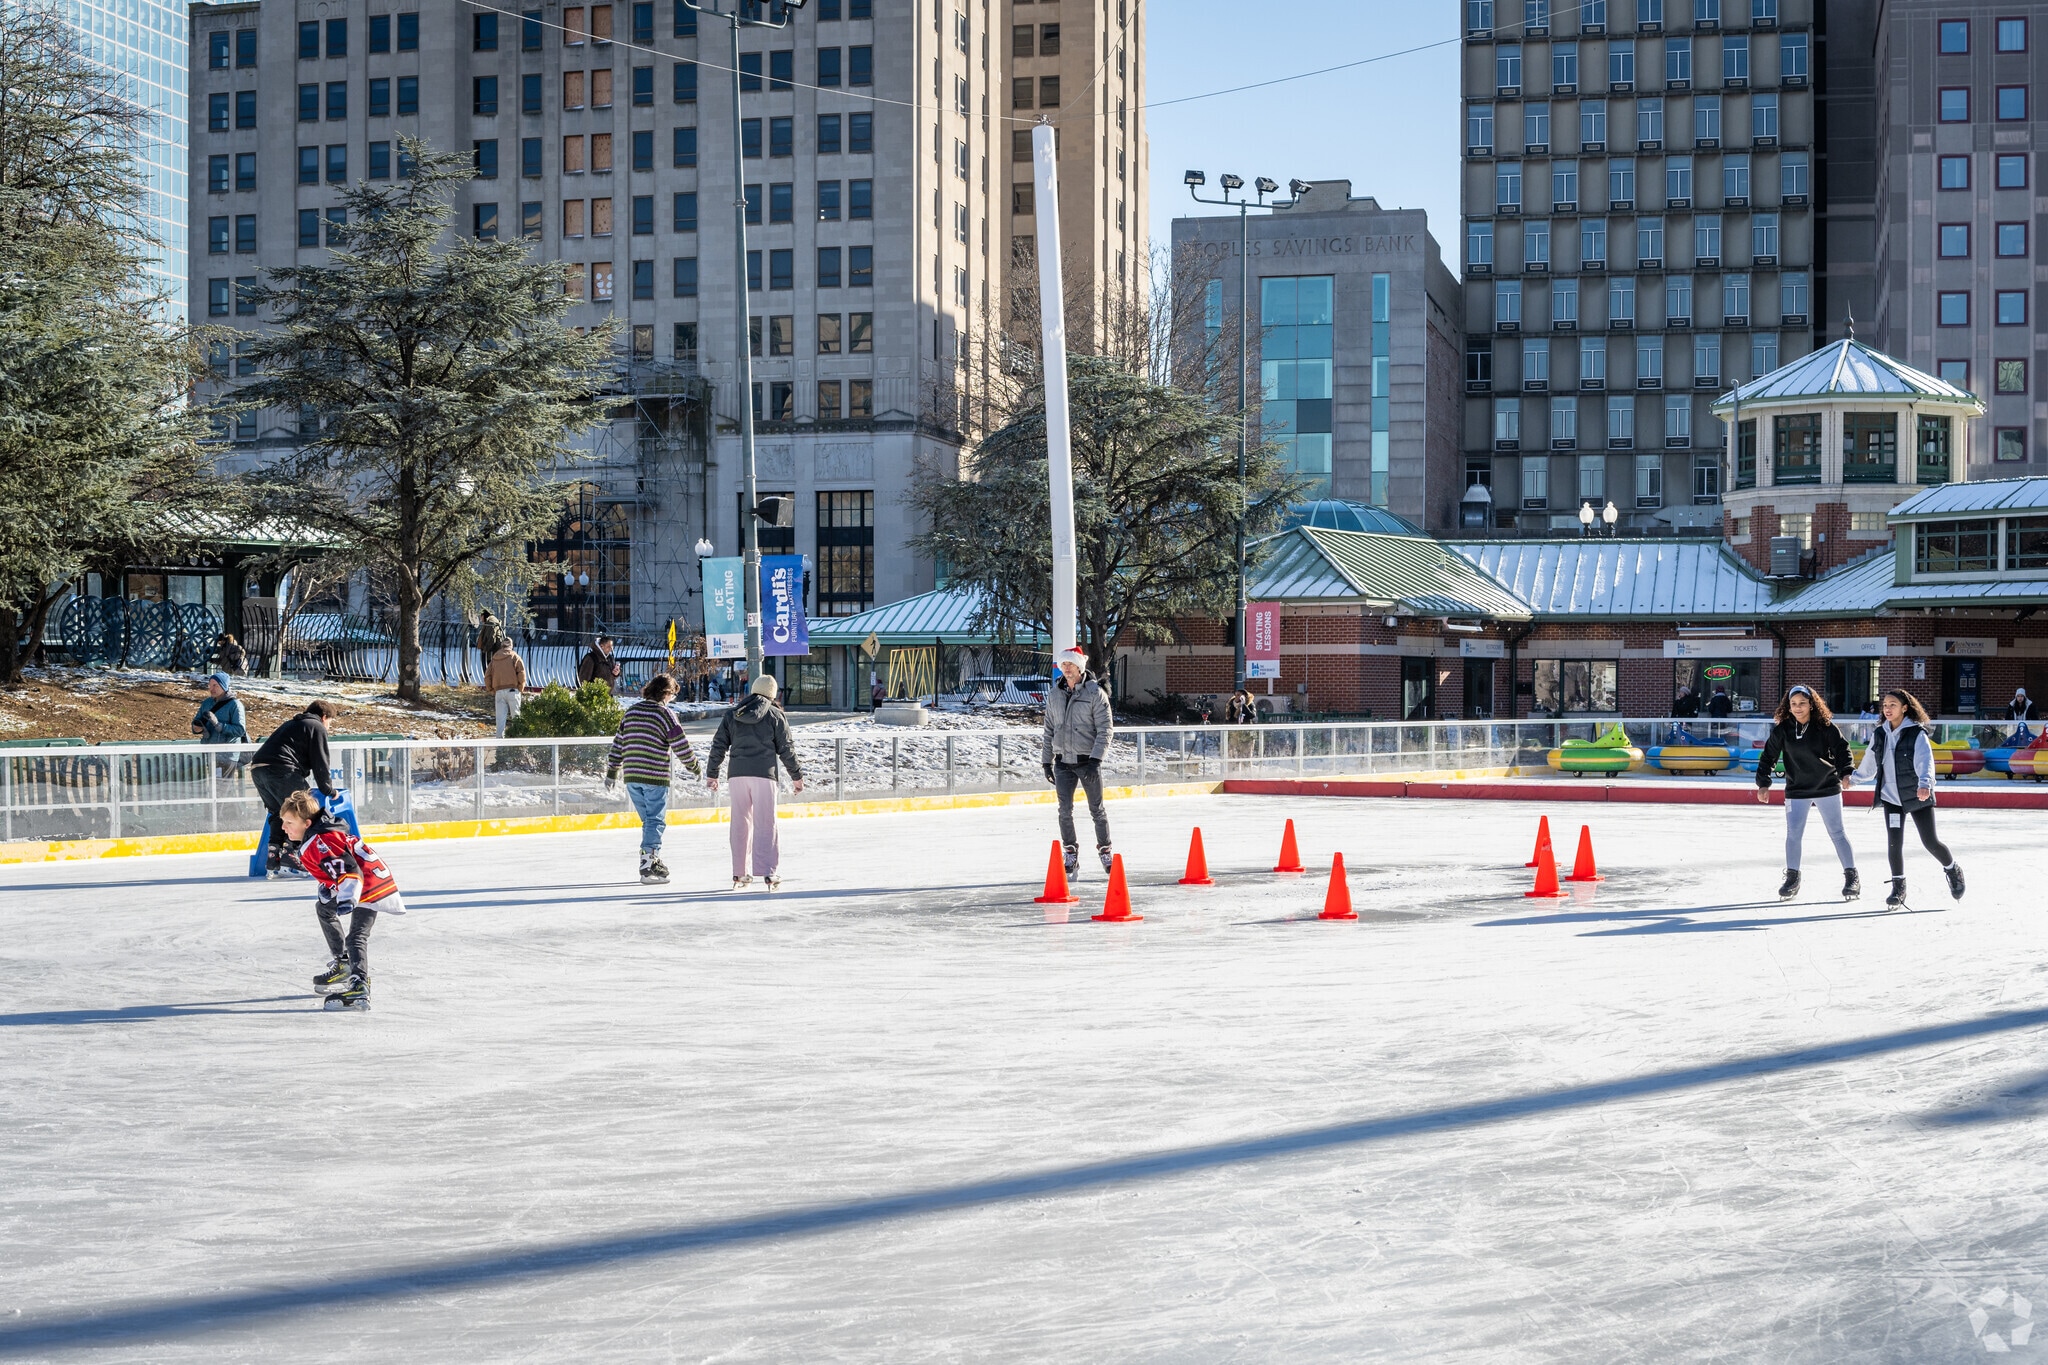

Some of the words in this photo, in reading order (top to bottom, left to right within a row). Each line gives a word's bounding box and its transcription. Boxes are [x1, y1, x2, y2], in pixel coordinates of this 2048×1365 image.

[1273, 237, 1352, 255] SAVINGS
[1365, 235, 1415, 252] BANK
[715, 588, 724, 607] ICE
[724, 570, 734, 621] SKATING
[771, 568, 790, 644] Cardi's
[1860, 643, 1877, 651] OFFICE
[1707, 668, 1731, 677] OPEN
